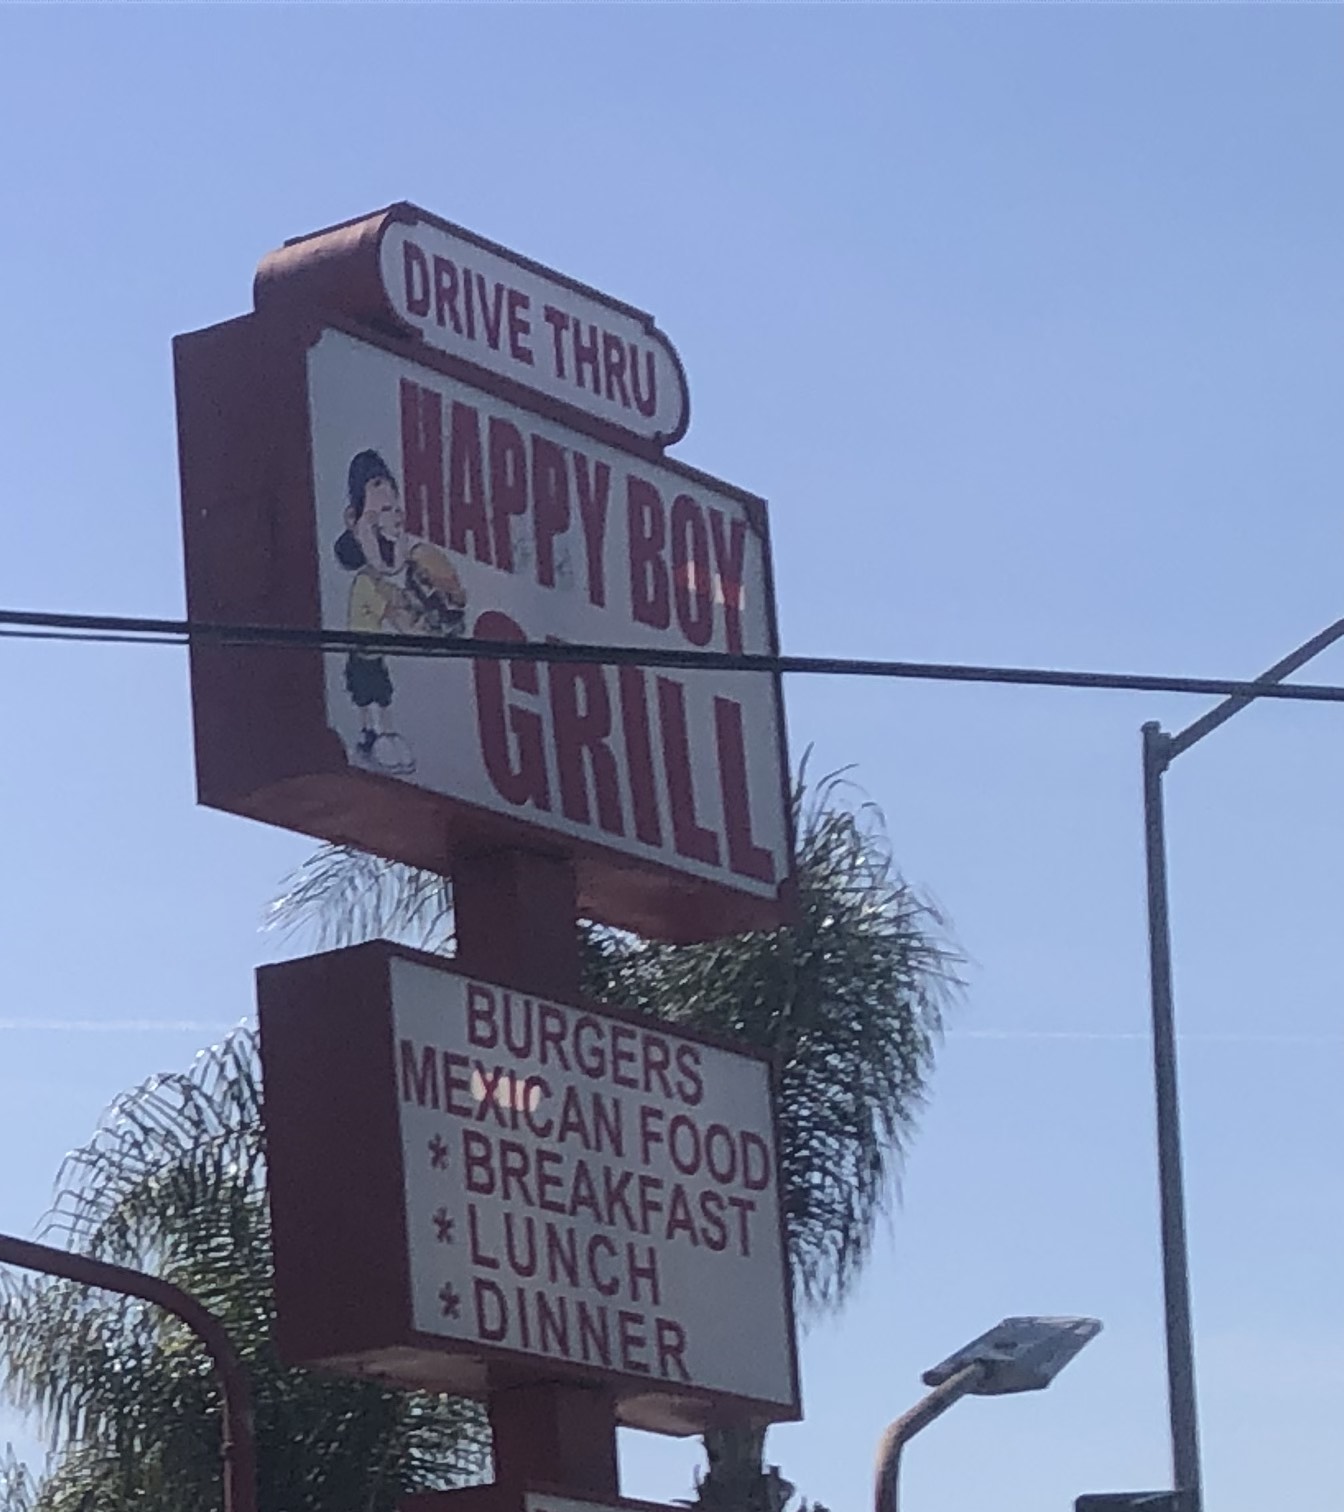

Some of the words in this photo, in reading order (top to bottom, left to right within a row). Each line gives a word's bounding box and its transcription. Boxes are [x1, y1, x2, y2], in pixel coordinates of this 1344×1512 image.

[403, 239, 534, 366] DRIVE
[544, 304, 657, 418] THRU
[399, 377, 612, 608] HAPPY
[627, 474, 748, 656] BOY
[473, 610, 776, 884] GRILL
[465, 984, 705, 1106] BURGERS
[400, 1040, 623, 1157] MEXICAN
[641, 1106, 771, 1191] FOOD
[462, 1128, 756, 1257] BREAKFAST
[467, 1204, 661, 1306] LUNCH
[473, 1278, 691, 1381] DINNER
